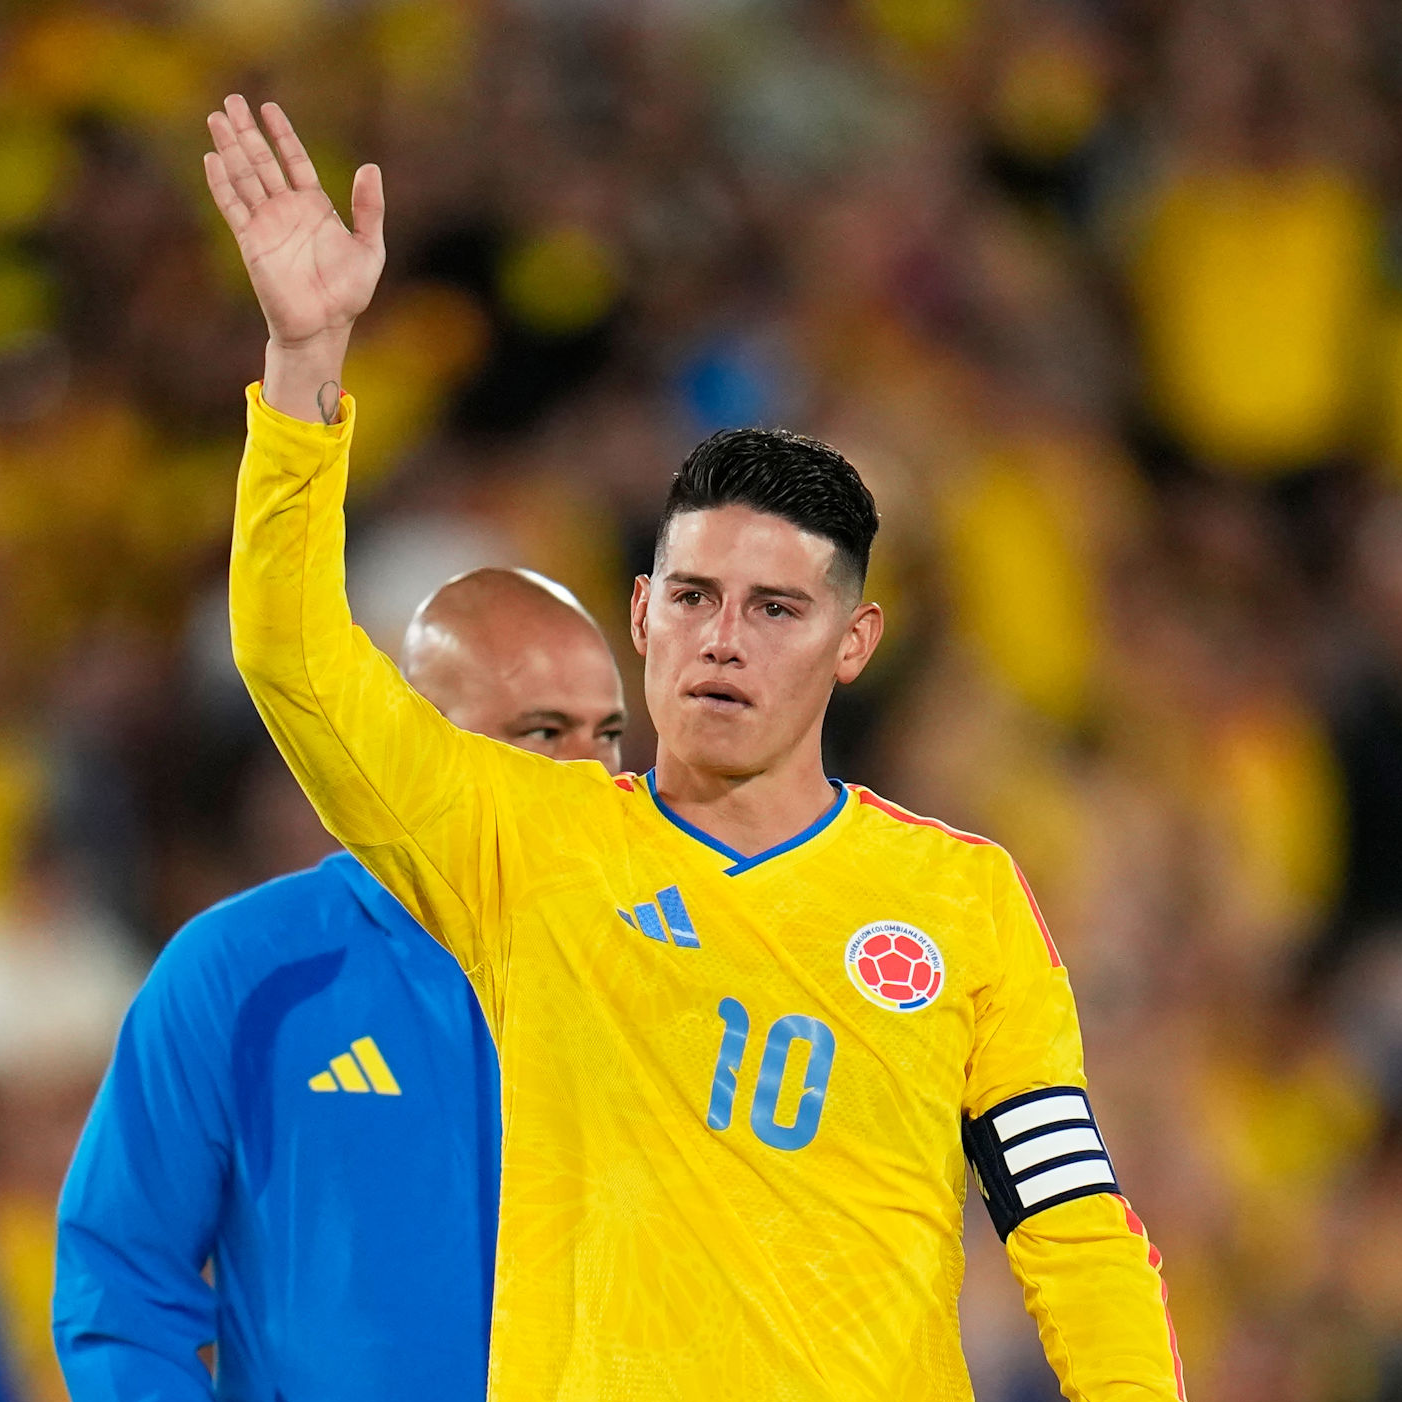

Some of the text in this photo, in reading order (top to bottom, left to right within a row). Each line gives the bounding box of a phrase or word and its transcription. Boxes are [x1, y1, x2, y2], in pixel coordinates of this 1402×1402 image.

[871, 924, 918, 938] COLOMBIANA
[918, 936, 927, 945] DE
[706, 996, 837, 1152] 10
